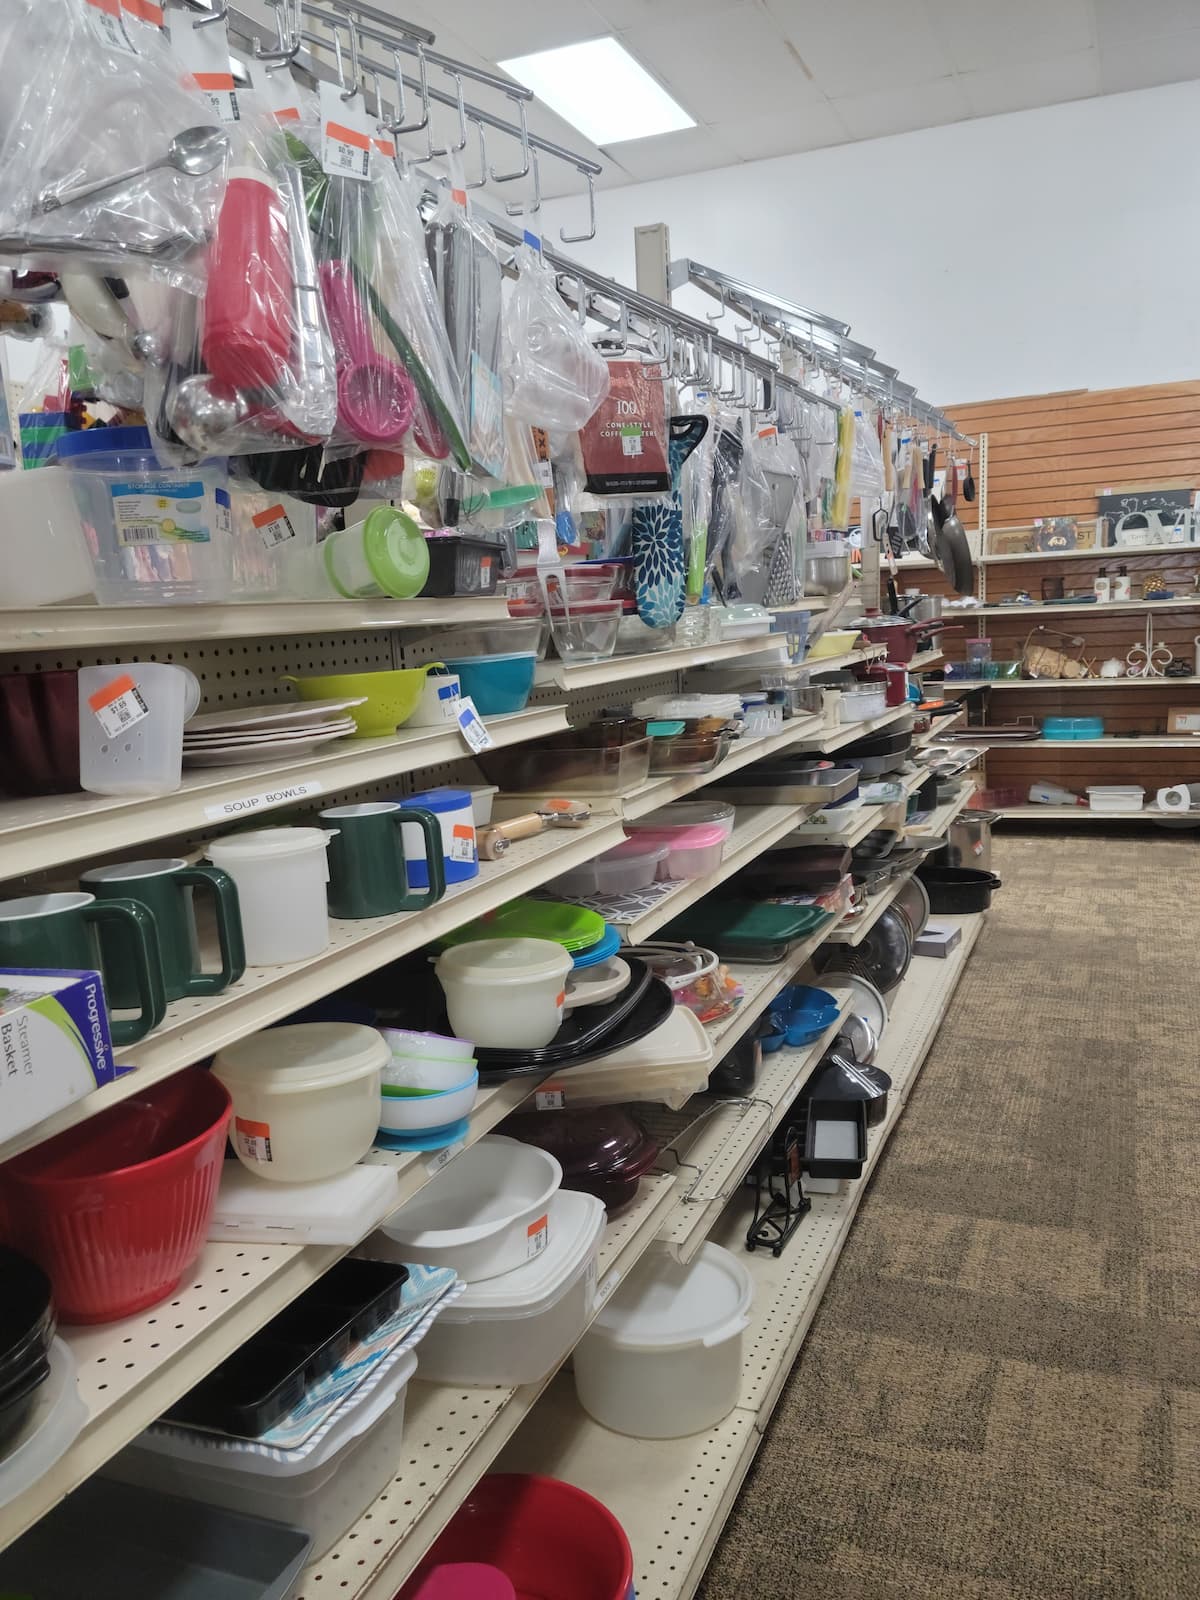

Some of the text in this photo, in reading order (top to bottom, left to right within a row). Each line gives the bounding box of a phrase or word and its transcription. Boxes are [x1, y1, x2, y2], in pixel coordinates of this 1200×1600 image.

[616, 400, 637, 415] 100
[223, 786, 308, 813] SOUP BOWLS
[1, 1022, 18, 1078] Basket
[16, 1015, 33, 1076] Steamer
[85, 983, 109, 1070] Progressive
